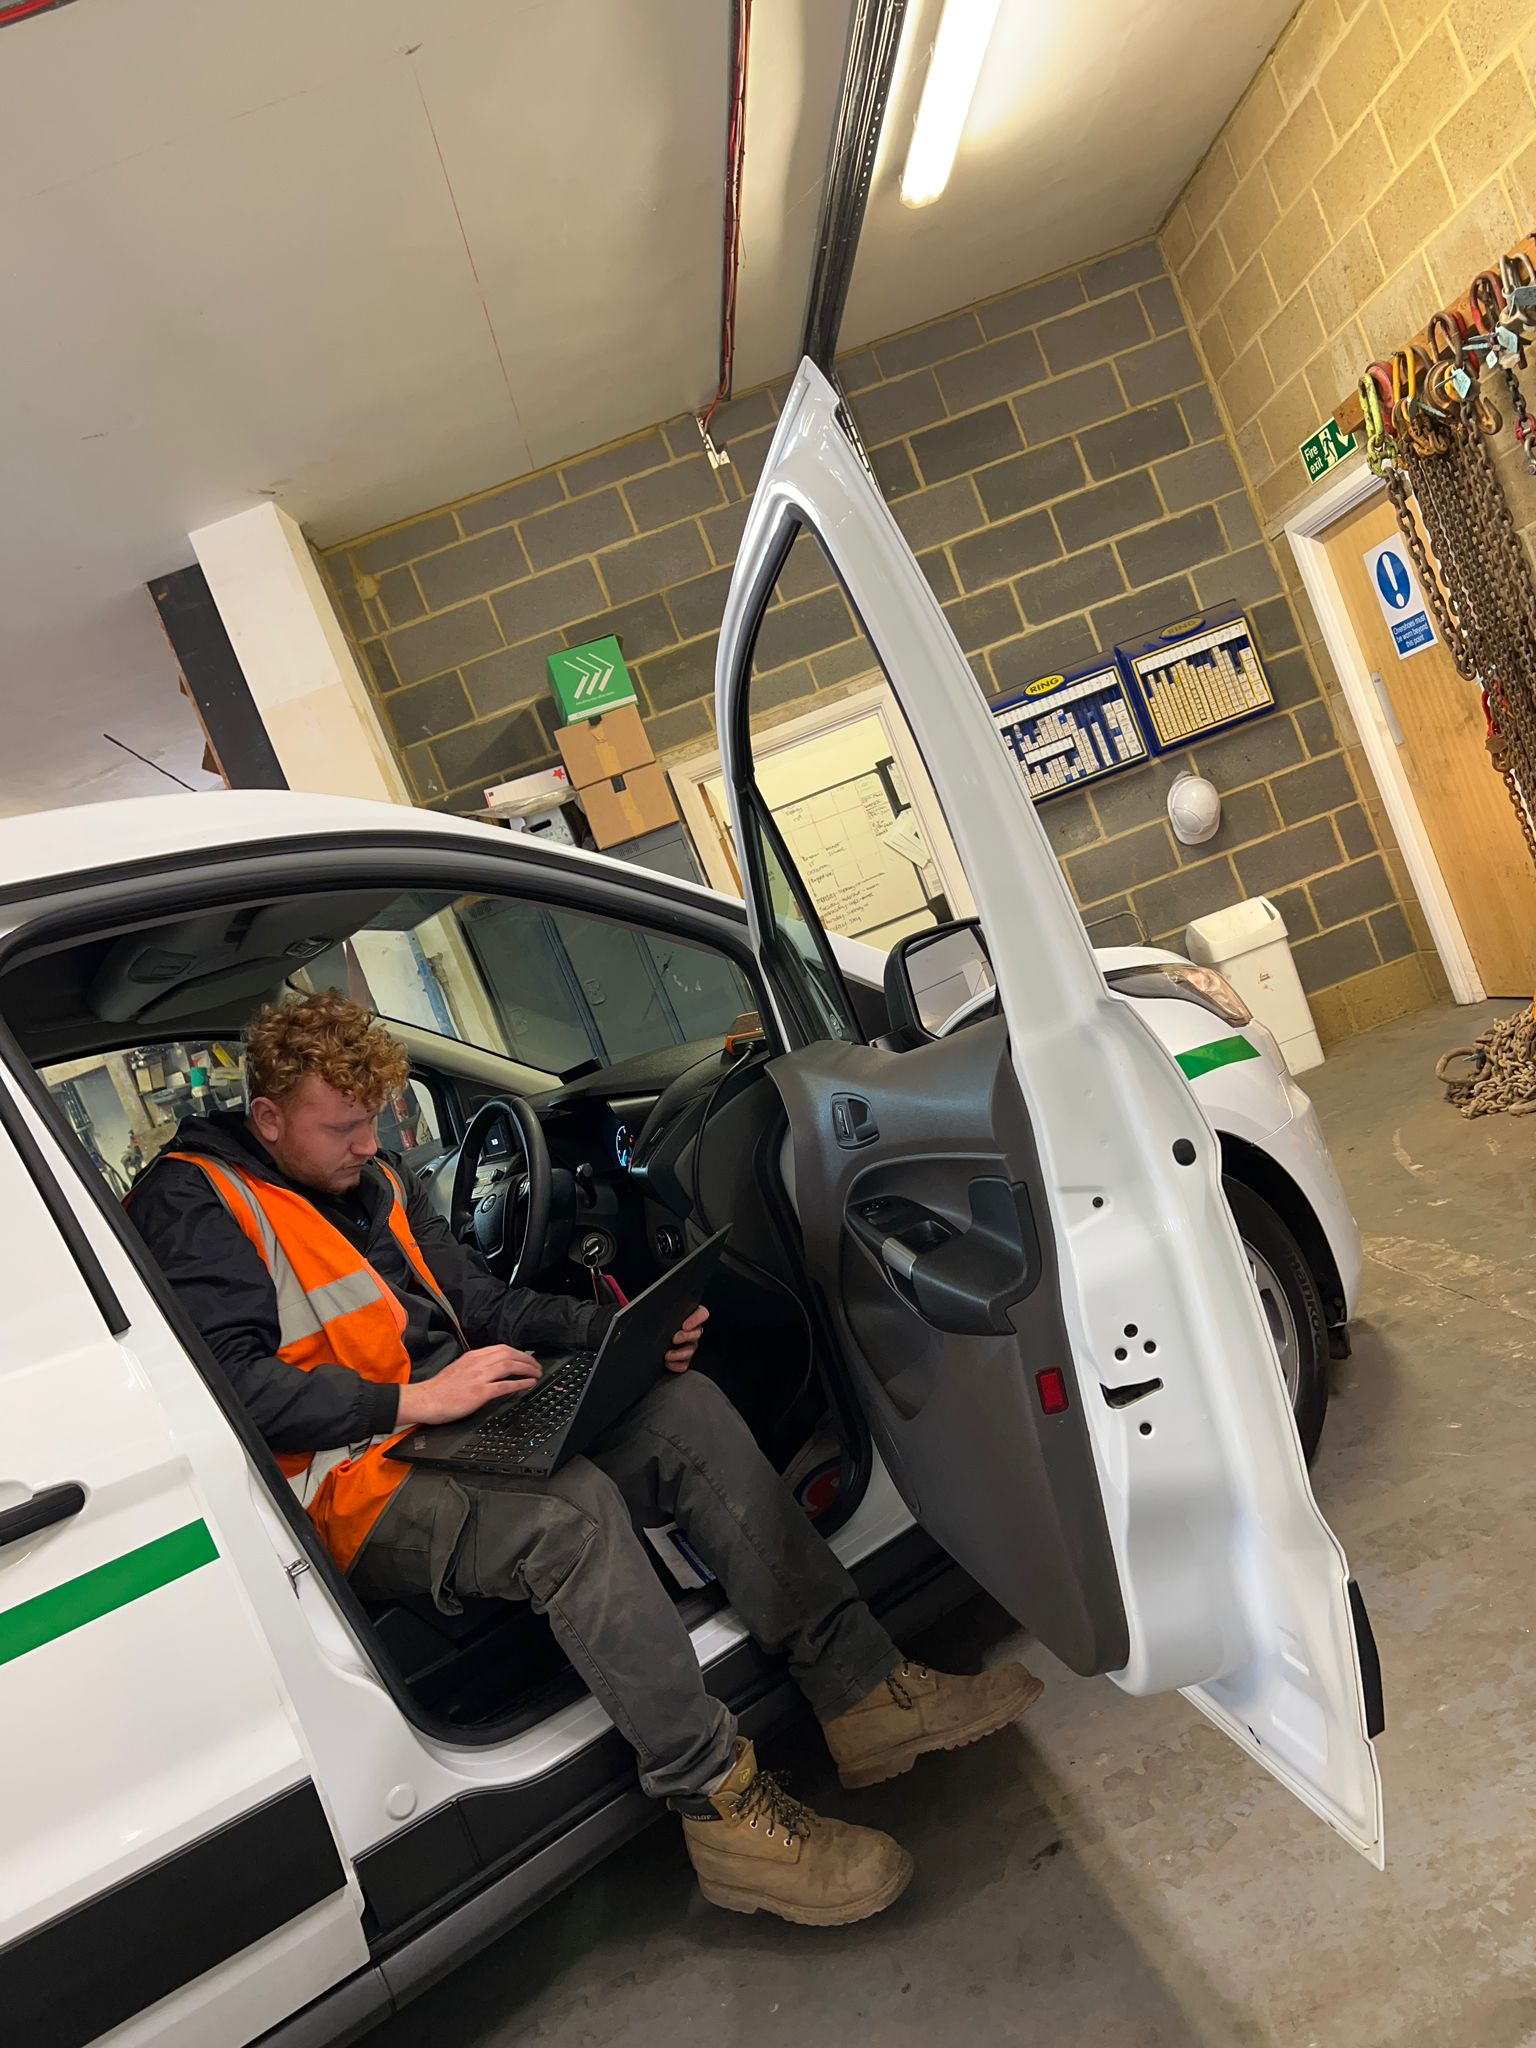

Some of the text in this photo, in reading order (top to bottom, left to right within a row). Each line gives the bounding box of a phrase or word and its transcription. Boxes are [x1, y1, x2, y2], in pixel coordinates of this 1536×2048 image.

[1304, 446, 1319, 462] Fire
[1310, 457, 1324, 474] exit
[1167, 620, 1197, 634] RING
[1393, 614, 1426, 635] Overshoes must
[1396, 621, 1429, 643] be worn beyond
[1405, 634, 1425, 648] this point
[1029, 677, 1060, 693] RING
